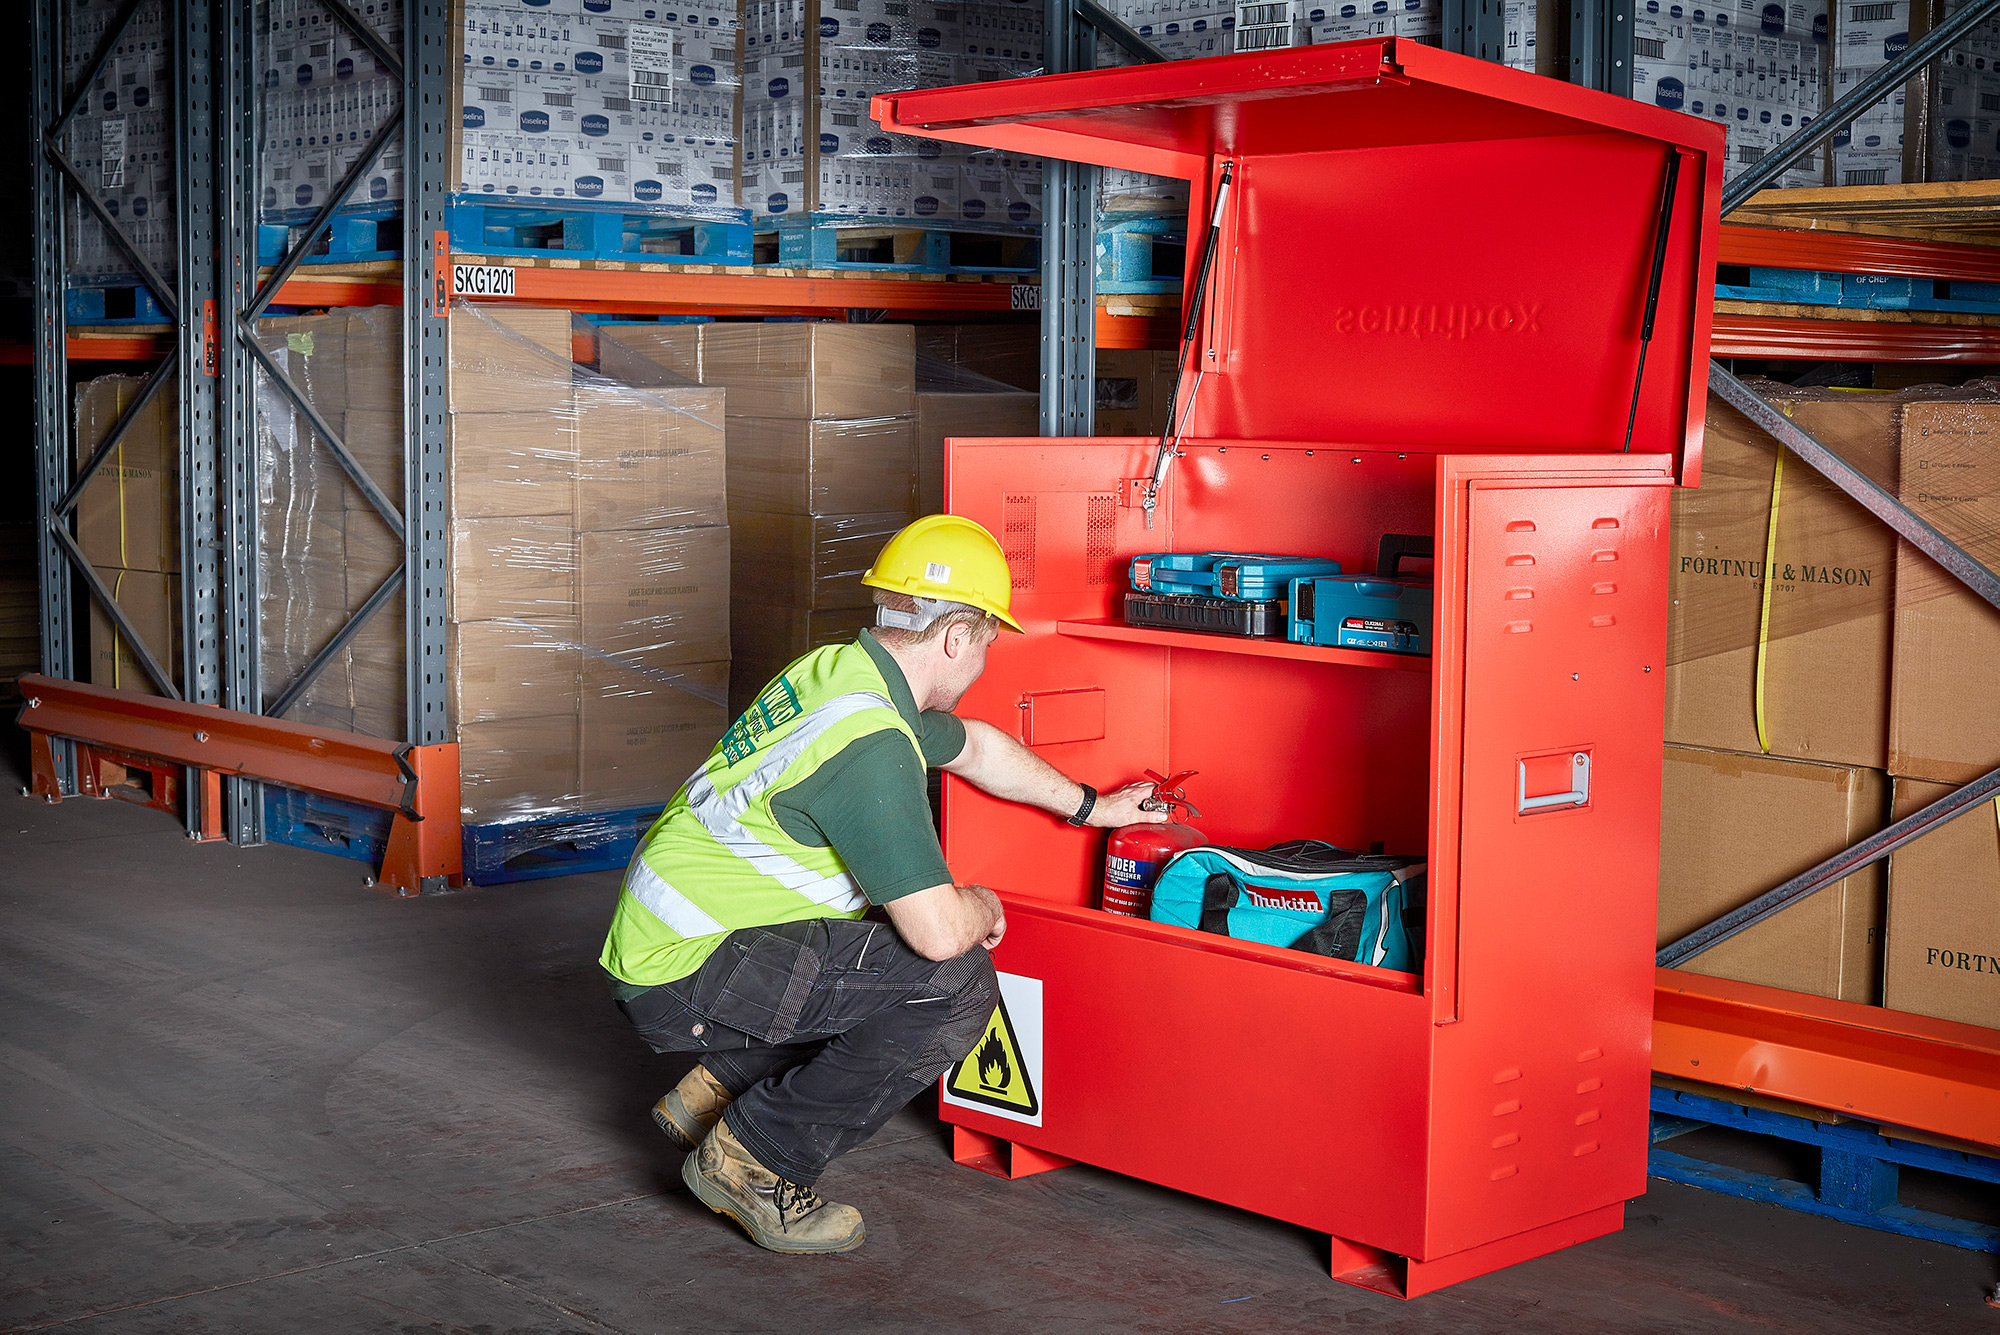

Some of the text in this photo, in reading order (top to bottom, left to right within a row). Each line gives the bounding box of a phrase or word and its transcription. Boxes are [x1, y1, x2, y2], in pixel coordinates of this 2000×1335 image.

[1762, 12, 1785, 25] Vaseline
[1886, 42, 1909, 52] Vase
[576, 58, 603, 67] Vaseline
[690, 70, 716, 79] Vaseline
[1658, 87, 1683, 99] Vaseline
[520, 117, 548, 126] Vaseline
[582, 122, 608, 131] Vaseline
[575, 182, 603, 191] Vaseline
[634, 186, 661, 195] Vaseline
[914, 202, 938, 210] Vaseline
[782, 234, 805, 242] PROPERTY
[455, 266, 516, 295] SKG1201
[1856, 276, 1867, 285] OF
[1012, 286, 1040, 309] SKG1
[128, 468, 152, 479] MASON
[1782, 564, 1796, 581] &
[1800, 565, 1872, 587] MASON
[1776, 584, 1796, 593] 1707
[1926, 948, 2000, 975] FORTN
